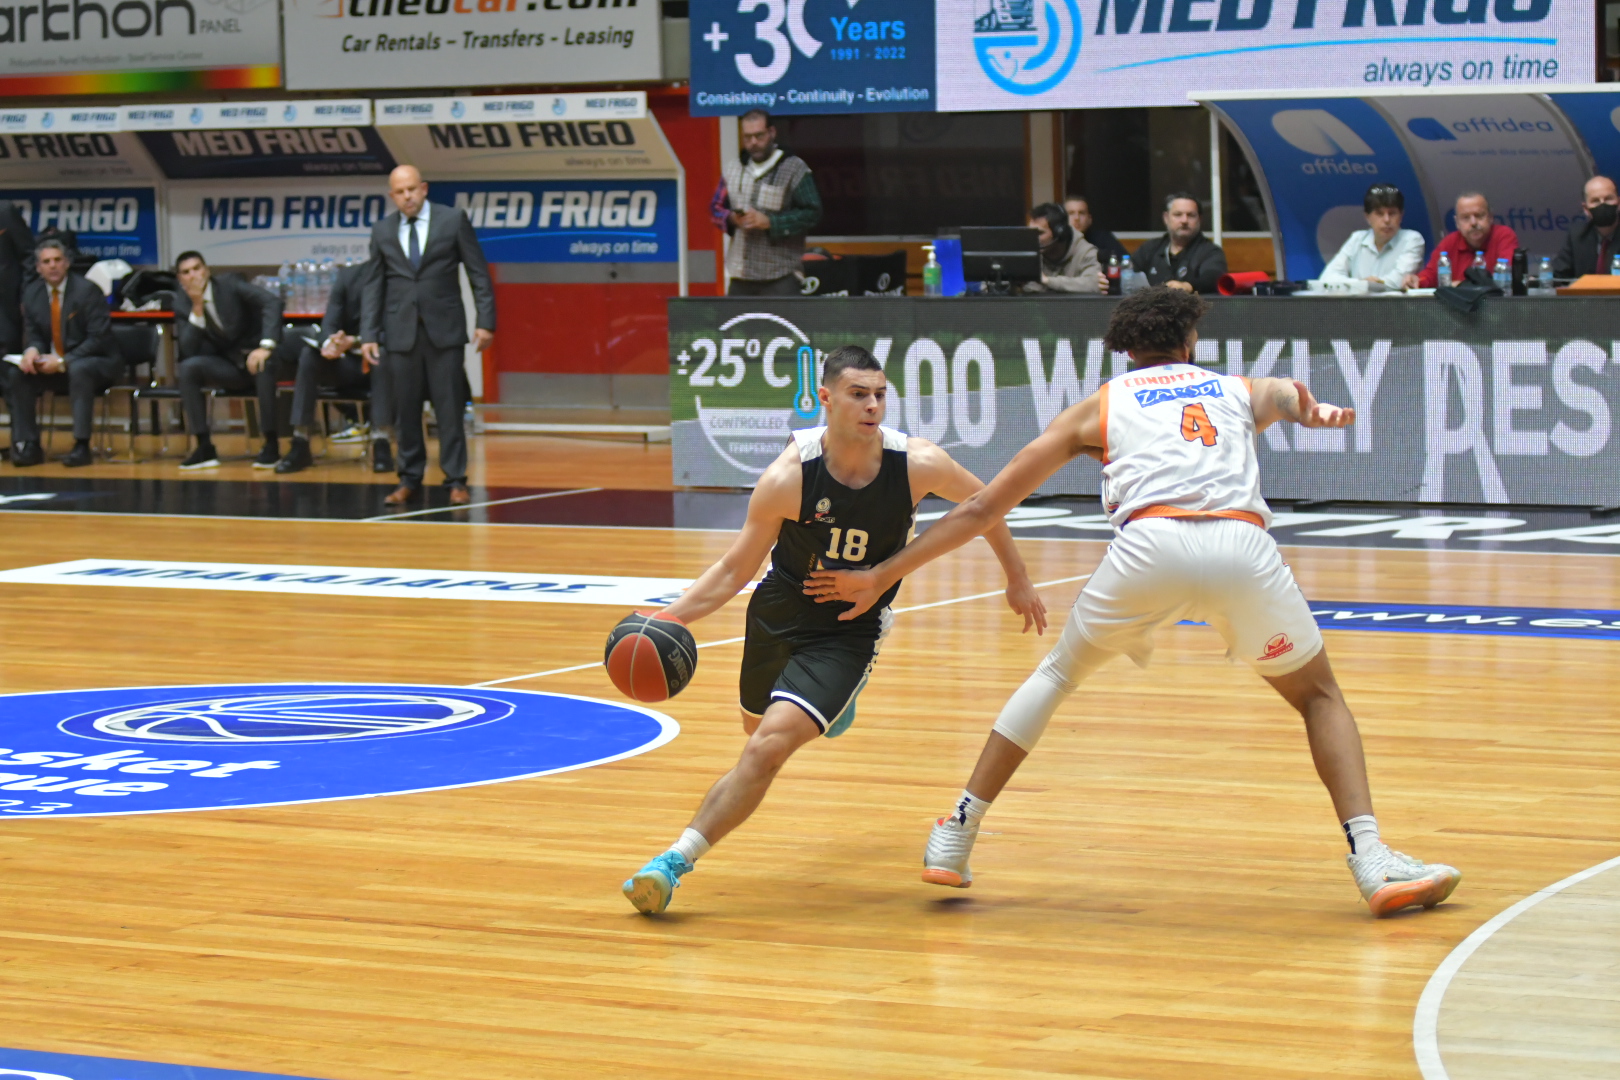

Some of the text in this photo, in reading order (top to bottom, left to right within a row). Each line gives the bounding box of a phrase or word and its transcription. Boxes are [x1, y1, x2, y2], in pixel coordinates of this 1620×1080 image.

[200, 18, 241, 34] PANEL
[342, 35, 371, 52] Car
[375, 32, 441, 51] Rentals
[463, 28, 545, 49] Transfers
[564, 25, 635, 49] Leasing
[830, 16, 906, 41] Years
[831, 48, 860, 61] 1991
[874, 47, 907, 60] 2022
[1363, 54, 1559, 87] always on time
[696, 91, 777, 107] Consistency
[787, 88, 855, 104] Continuity
[865, 86, 930, 101] Evolution
[427, 120, 636, 149] MED FRIGO
[1453, 116, 1554, 133] affidea
[11, 133, 119, 158] FRIGO
[172, 127, 368, 157] MED FRIGO
[1302, 158, 1379, 175] affidea
[37, 198, 139, 232] FRIGO
[200, 194, 386, 231] MED FRIGO
[453, 189, 657, 229] MED FRIGO
[569, 239, 658, 257] always on time
[1021, 338, 1393, 453] WKLY
[1180, 402, 1218, 447] 4
[825, 527, 869, 562] 18
